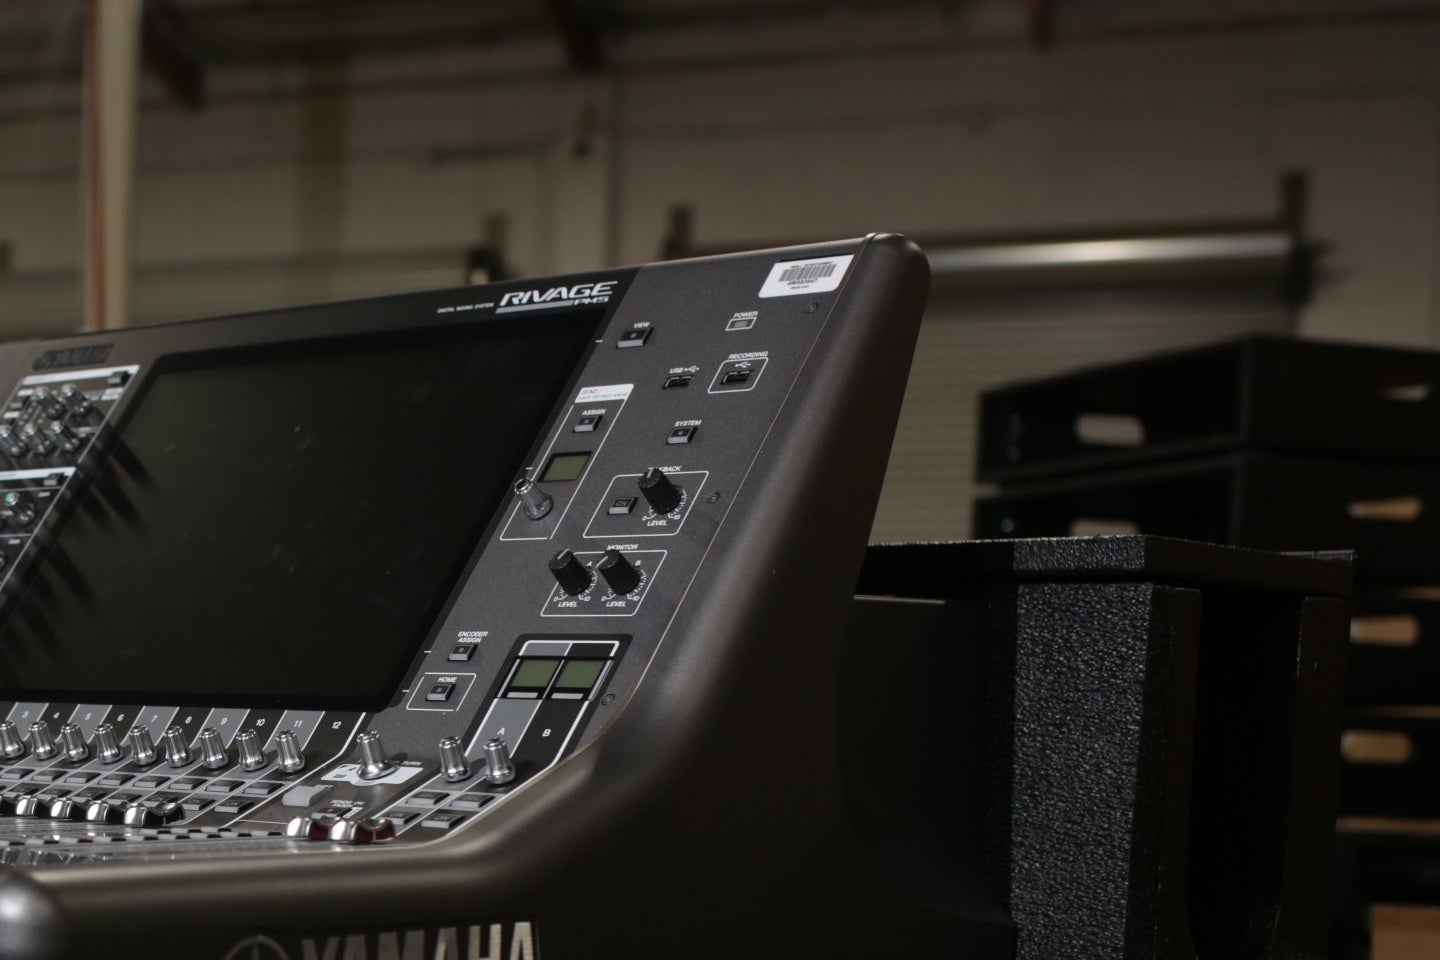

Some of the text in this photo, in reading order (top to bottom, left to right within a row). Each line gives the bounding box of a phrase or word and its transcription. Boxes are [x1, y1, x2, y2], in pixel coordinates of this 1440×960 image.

[499, 281, 618, 306] RIVAGE
[732, 311, 759, 319] POWER
[633, 321, 651, 329] VIEW
[728, 351, 769, 360] RECORDING
[674, 419, 702, 427] SYSTEM
[21, 710, 30, 719] 3
[52, 711, 61, 720] 4
[84, 713, 92, 721] 5
[117, 713, 125, 722] 6
[152, 714, 159, 723] 7
[185, 715, 192, 724] 8
[220, 717, 228, 726] 9
[256, 718, 265, 727] 10
[294, 720, 303, 728] 11
[332, 721, 341, 729] 12
[497, 727, 505, 736] A
[542, 728, 551, 738] B
